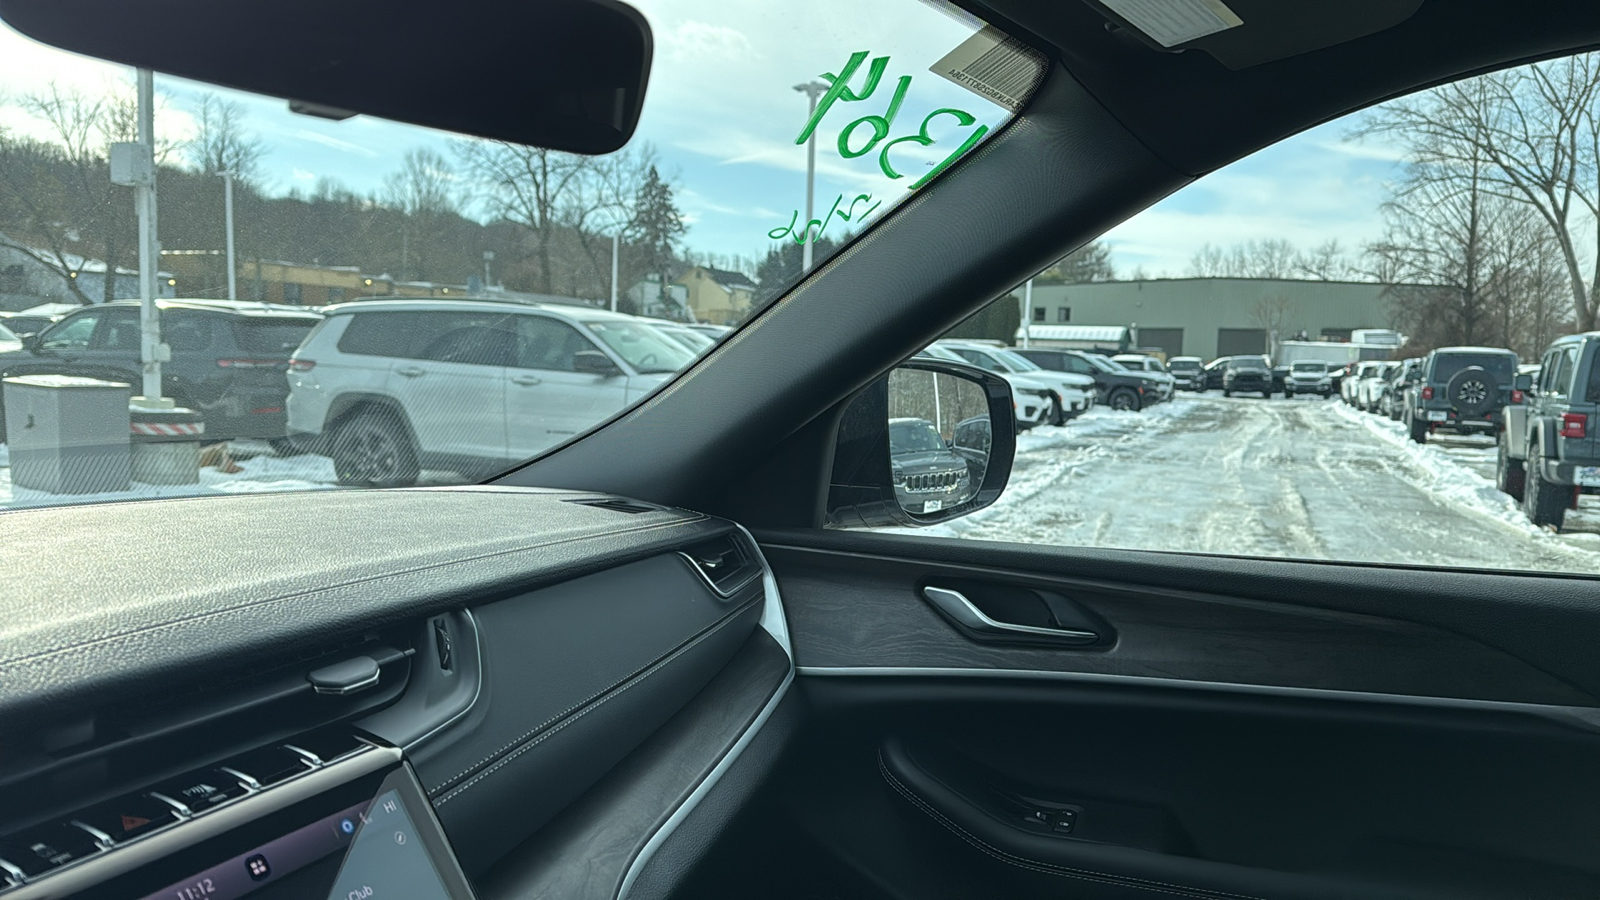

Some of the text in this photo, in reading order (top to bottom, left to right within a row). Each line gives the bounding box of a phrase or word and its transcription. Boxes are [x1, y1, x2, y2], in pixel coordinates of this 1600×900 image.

[383, 800, 397, 814] HI
[176, 878, 216, 900] 11:12
[348, 885, 374, 900] Club
